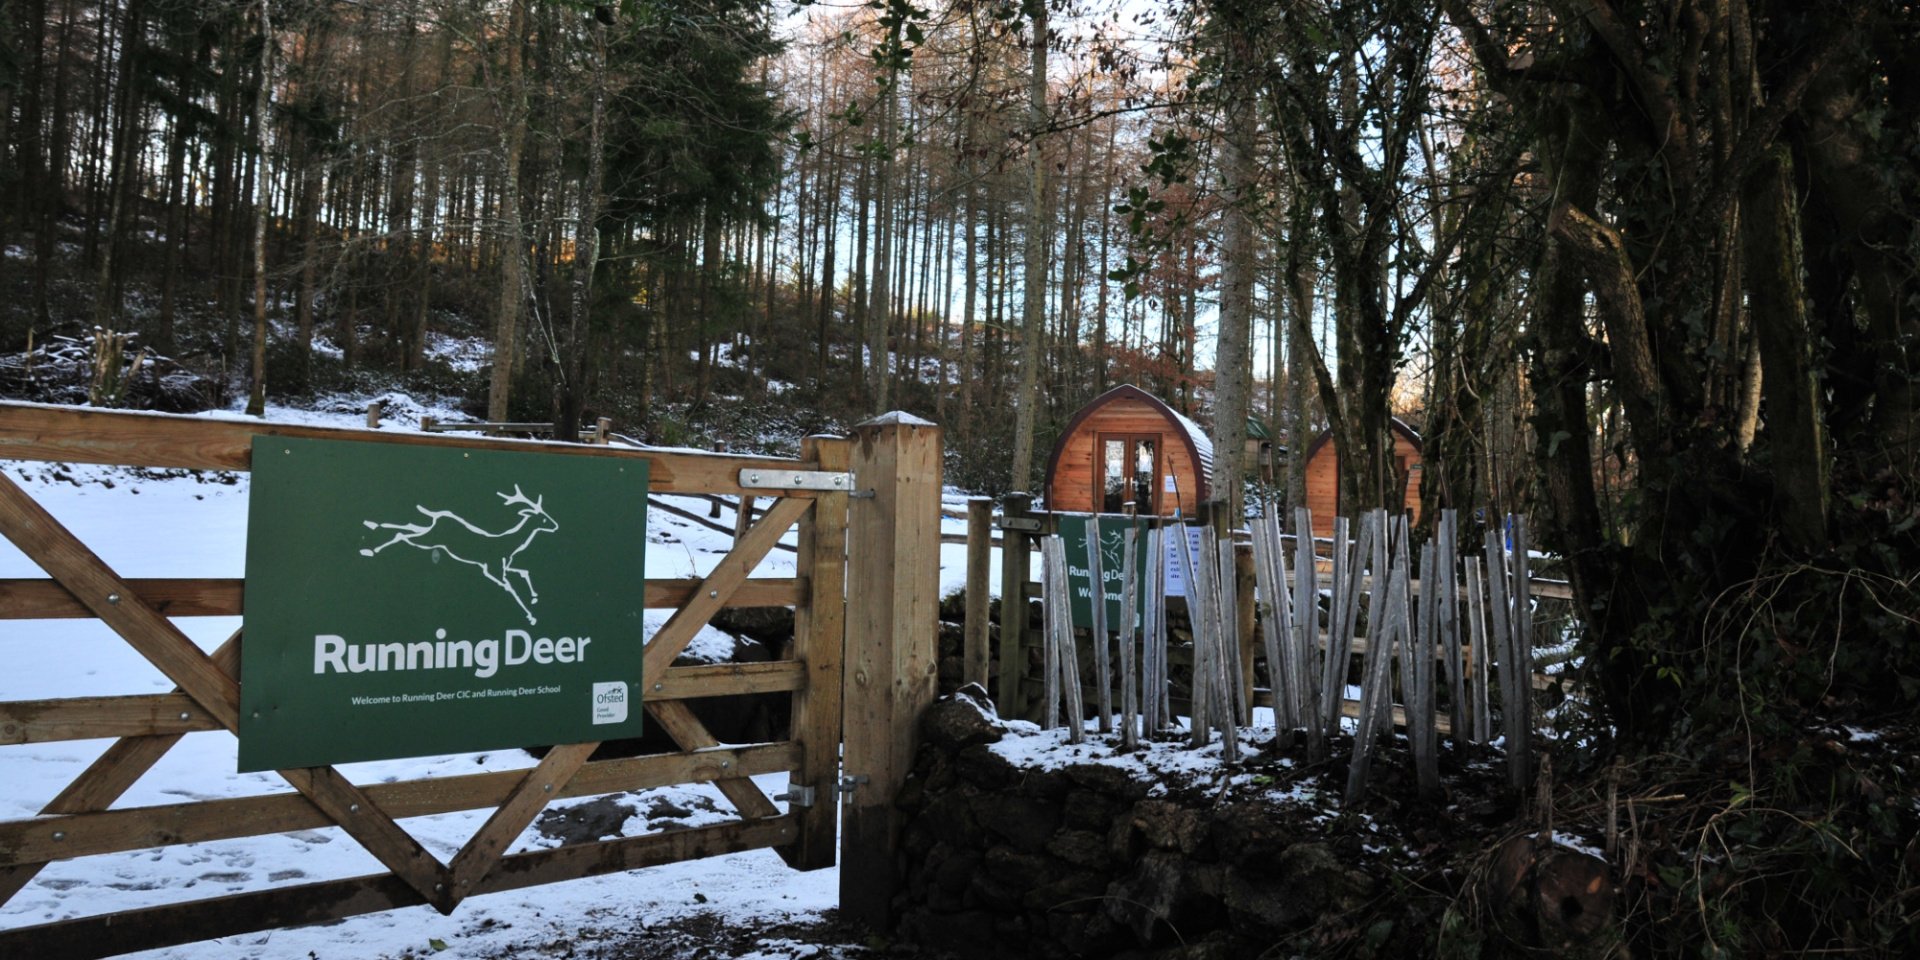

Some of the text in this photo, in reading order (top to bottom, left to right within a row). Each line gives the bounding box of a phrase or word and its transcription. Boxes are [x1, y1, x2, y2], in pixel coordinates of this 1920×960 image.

[1069, 565, 1124, 582] Rung De
[314, 628, 591, 678] Running Deer
[351, 685, 561, 705] Welcome to Running Deer CIC and Running Deer School
[597, 693, 624, 704] Ofsted
